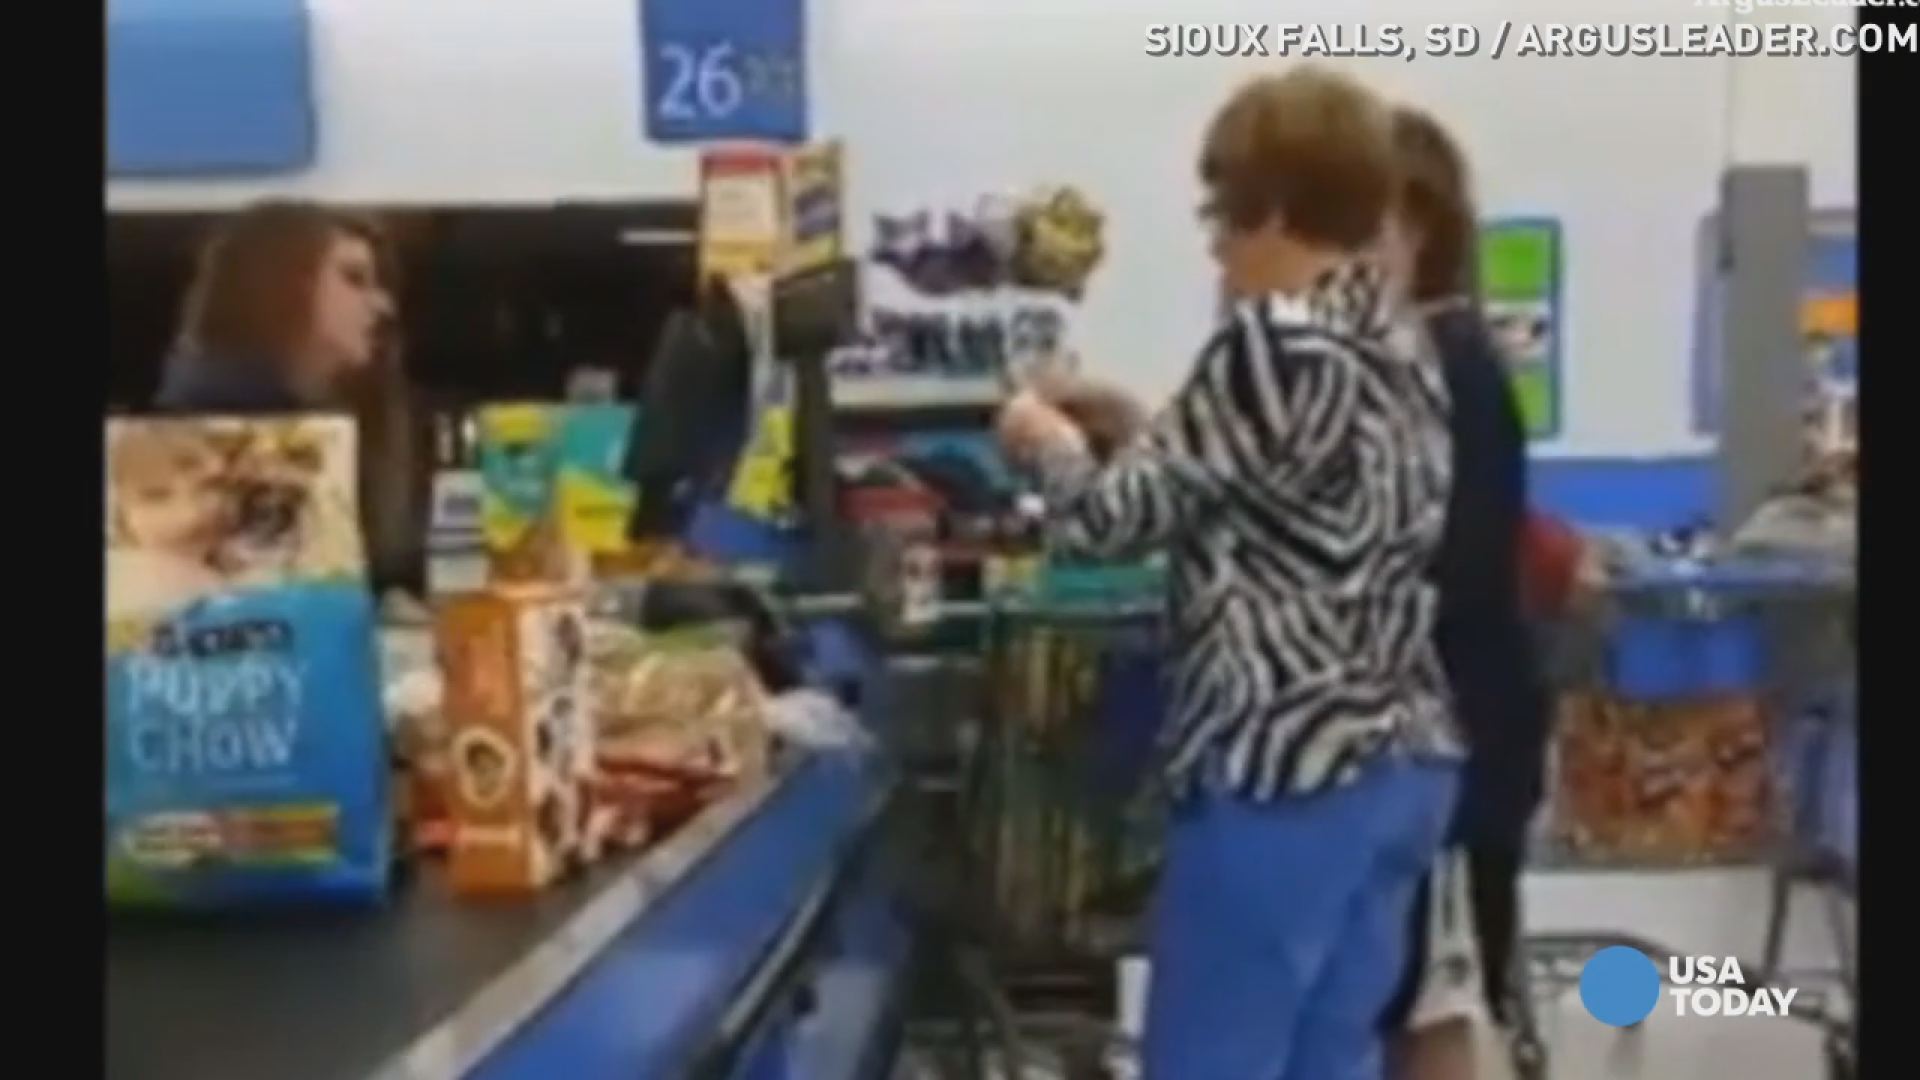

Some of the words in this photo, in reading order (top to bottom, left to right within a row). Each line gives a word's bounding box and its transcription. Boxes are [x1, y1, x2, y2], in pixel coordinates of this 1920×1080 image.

[658, 41, 743, 119] 26
[127, 655, 310, 716] PUPPY
[130, 718, 300, 772] CHOW
